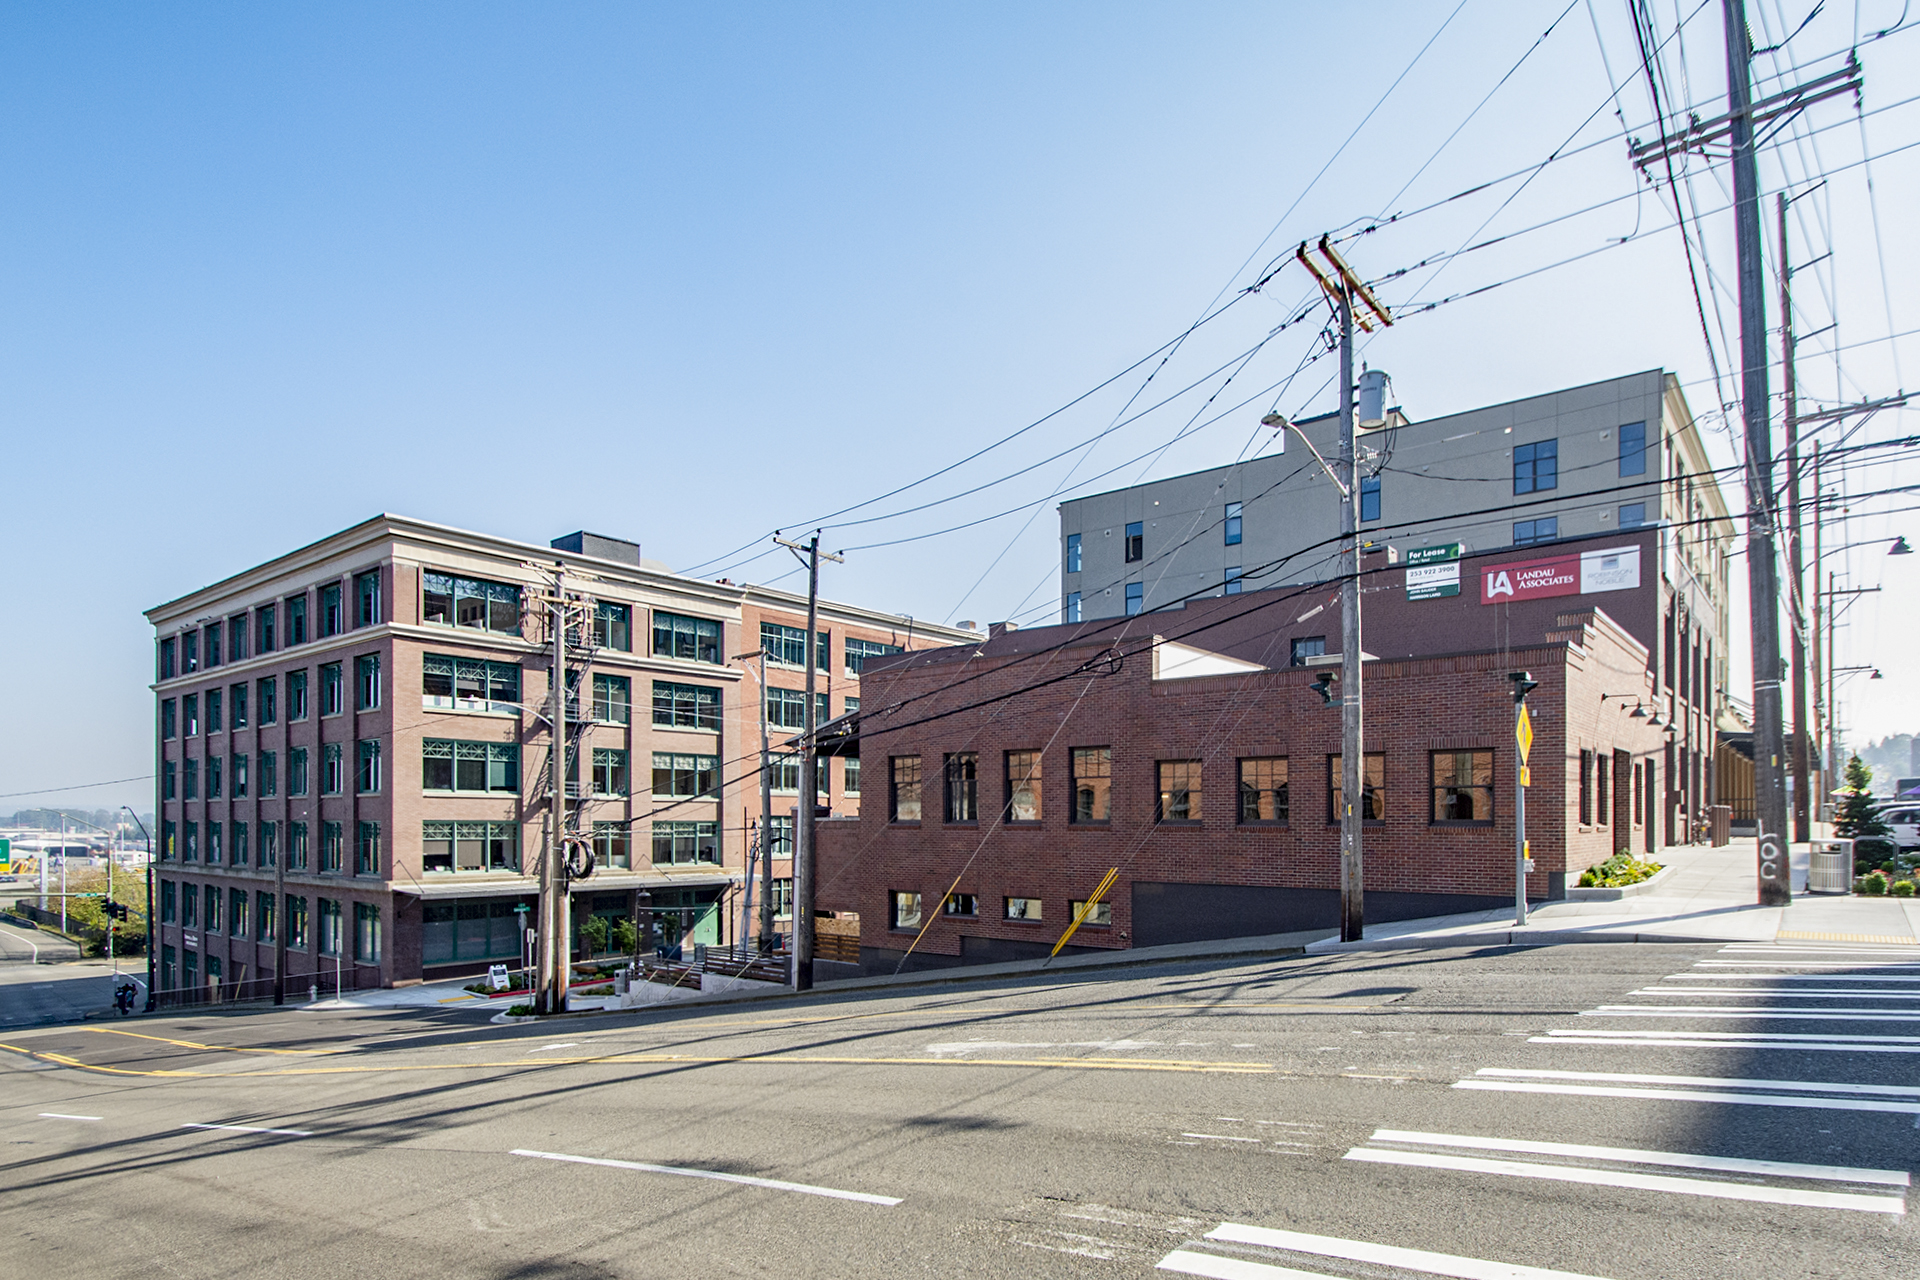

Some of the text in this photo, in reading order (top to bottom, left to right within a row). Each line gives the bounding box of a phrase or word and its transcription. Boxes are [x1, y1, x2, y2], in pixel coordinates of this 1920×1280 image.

[1409, 549, 1446, 559] For Lease
[1516, 568, 1555, 580] LANDAU
[1518, 575, 1574, 589] ASSOCIATES
